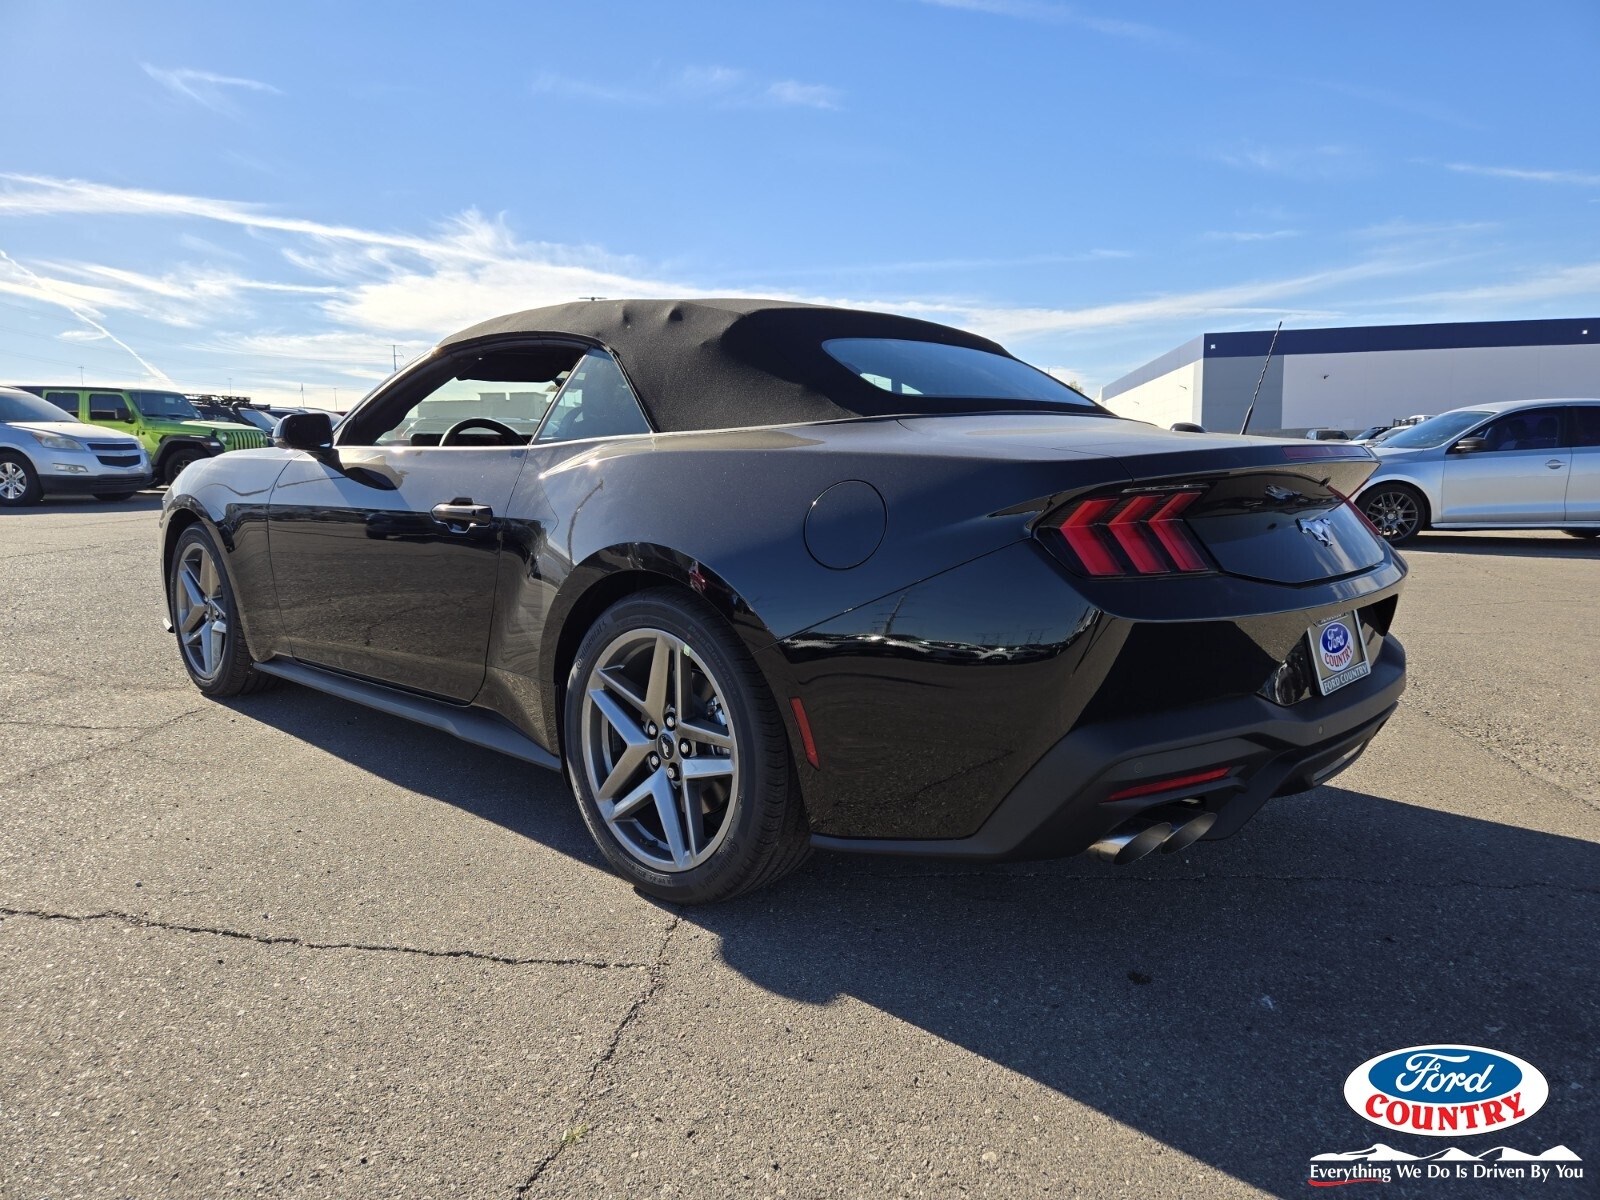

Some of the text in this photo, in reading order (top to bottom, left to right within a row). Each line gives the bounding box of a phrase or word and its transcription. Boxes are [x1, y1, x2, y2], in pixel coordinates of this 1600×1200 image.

[1326, 627, 1345, 651] Ford
[1324, 643, 1353, 667] COUNTRY
[1323, 665, 1368, 692] FORD COUNTRY
